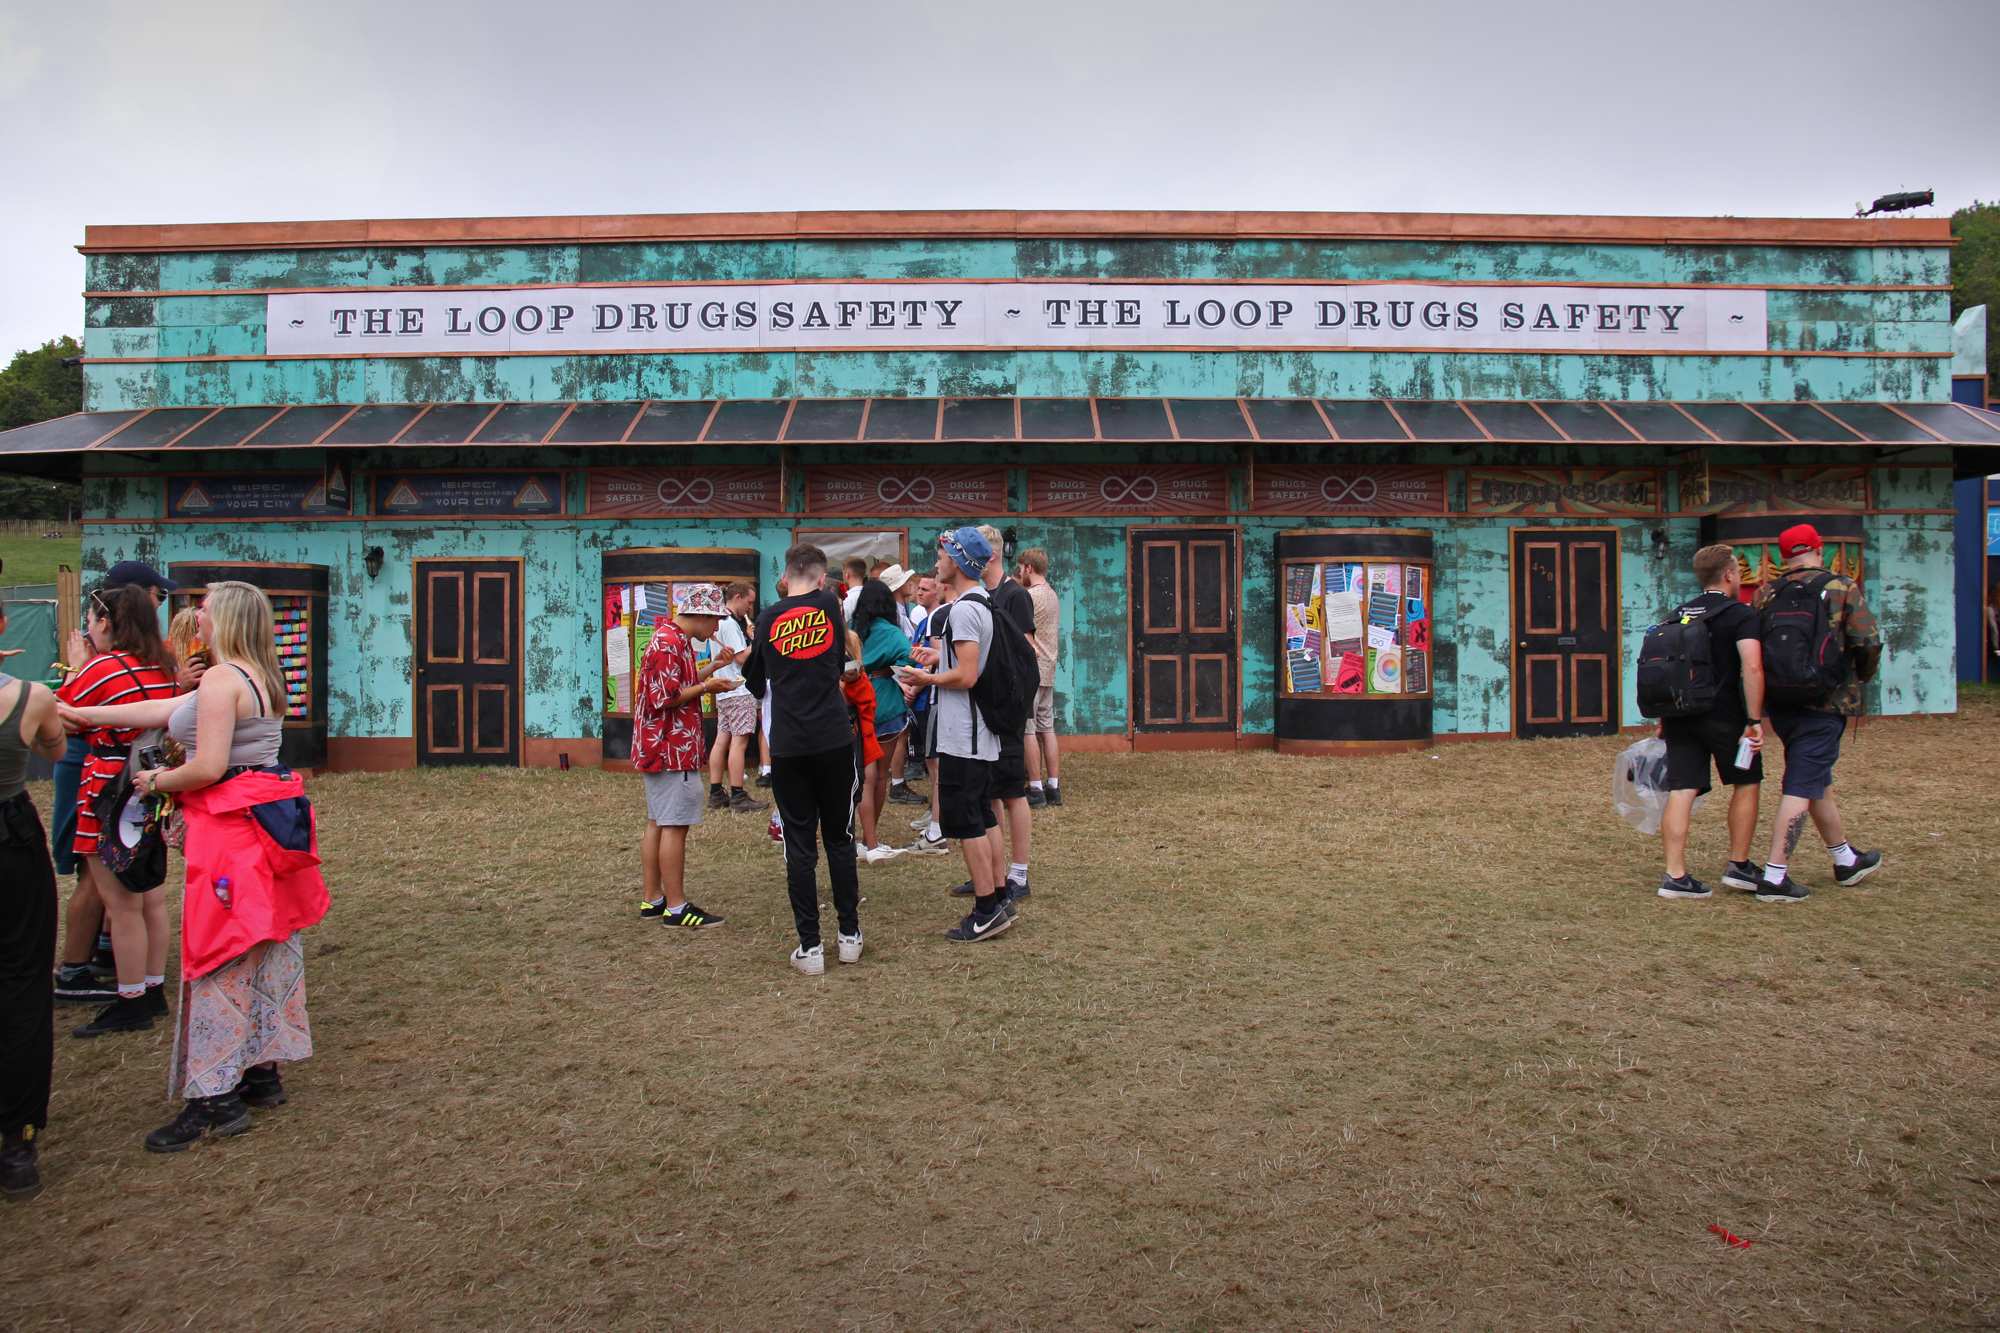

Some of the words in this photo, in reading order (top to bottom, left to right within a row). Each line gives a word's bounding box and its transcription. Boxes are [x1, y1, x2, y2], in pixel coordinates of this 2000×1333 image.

[332, 307, 424, 336] THE
[446, 304, 574, 335] LOOP
[593, 300, 757, 332] DRUGS
[770, 300, 962, 330] SAFETY
[1046, 299, 1141, 328] THE
[1163, 299, 1293, 328] LOOP
[1316, 300, 1479, 330] DRUGS
[1500, 301, 1684, 333] SAFETY
[607, 483, 642, 491] DRUGS
[728, 482, 764, 490] DRUGS
[827, 481, 863, 489] DRUGS
[950, 481, 985, 489] DRUGS
[1050, 480, 1086, 489] DRUGS
[1172, 480, 1208, 488] DRUGS
[1271, 480, 1306, 488] DRUGS
[1392, 481, 1427, 489] DRUGS
[605, 494, 644, 502] SAFETY
[726, 492, 766, 501] SAFETY
[825, 492, 865, 501] SAFETY
[947, 492, 987, 500] SAFETY
[1047, 492, 1088, 500] SAFETY
[1170, 491, 1210, 499] SAFETY
[1268, 491, 1308, 499] SAFETY
[1389, 492, 1429, 500] SAFETY
[263, 500, 291, 509] CITY
[474, 498, 502, 506] CITY
[768, 610, 826, 642] SANTA
[781, 628, 827, 656] CRUZ
